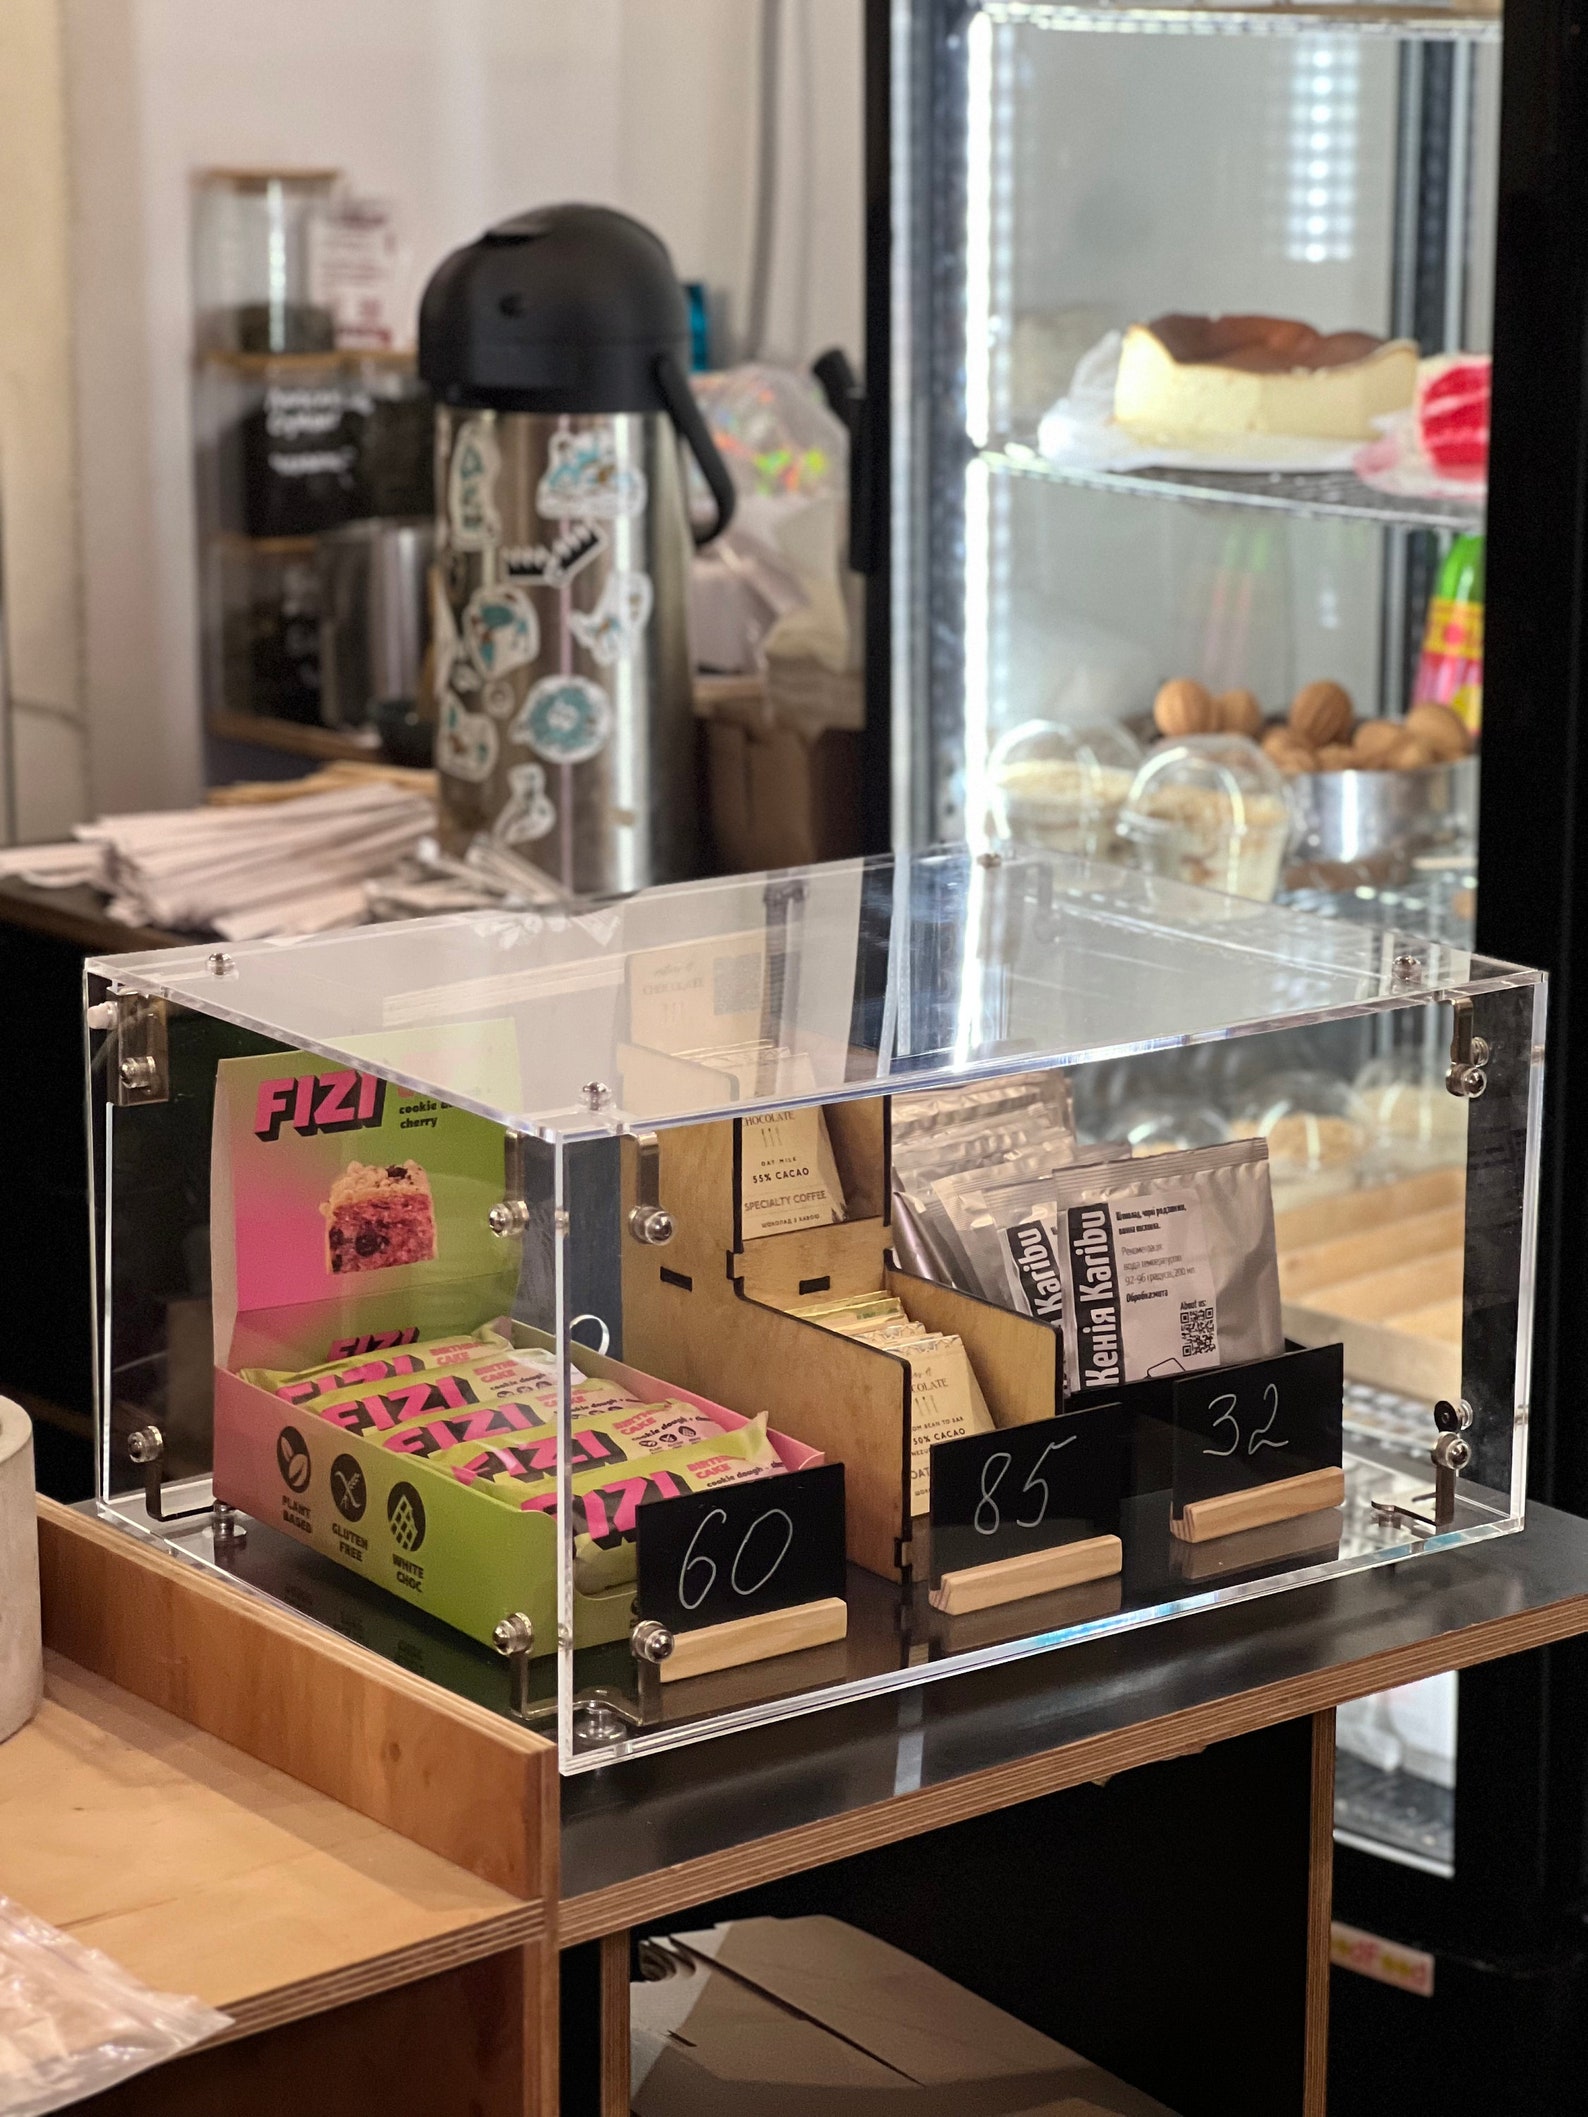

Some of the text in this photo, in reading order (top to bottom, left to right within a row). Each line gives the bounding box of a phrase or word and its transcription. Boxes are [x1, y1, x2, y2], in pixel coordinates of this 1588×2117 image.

[255, 1068, 387, 1141] FIZI
[399, 1100, 438, 1115] cookie
[400, 1116, 438, 1129] cherry
[752, 1167, 810, 1184] 55% CACAO
[744, 1189, 827, 1212] SPECIALTY COFFEE
[1017, 1227, 1063, 1316] Karibu
[1073, 1210, 1120, 1387] Кенія Karibu
[320, 1375, 479, 1437] FIZI
[382, 1402, 545, 1459] FIZI
[1202, 1383, 1290, 1457] 32
[934, 1427, 967, 1442] CACAO
[451, 1429, 628, 1486] FIZI
[696, 1463, 731, 1480] CAKE
[706, 1466, 764, 1488] cookie dough
[974, 1435, 1078, 1536] 85
[282, 1494, 312, 1519] PLANT
[282, 1510, 313, 1534] BASED
[331, 1522, 369, 1551] GLUTEN
[339, 1541, 363, 1562] FREE
[679, 1508, 793, 1610] 60
[392, 1553, 425, 1580] WHITE
[396, 1571, 423, 1593] CHOC
